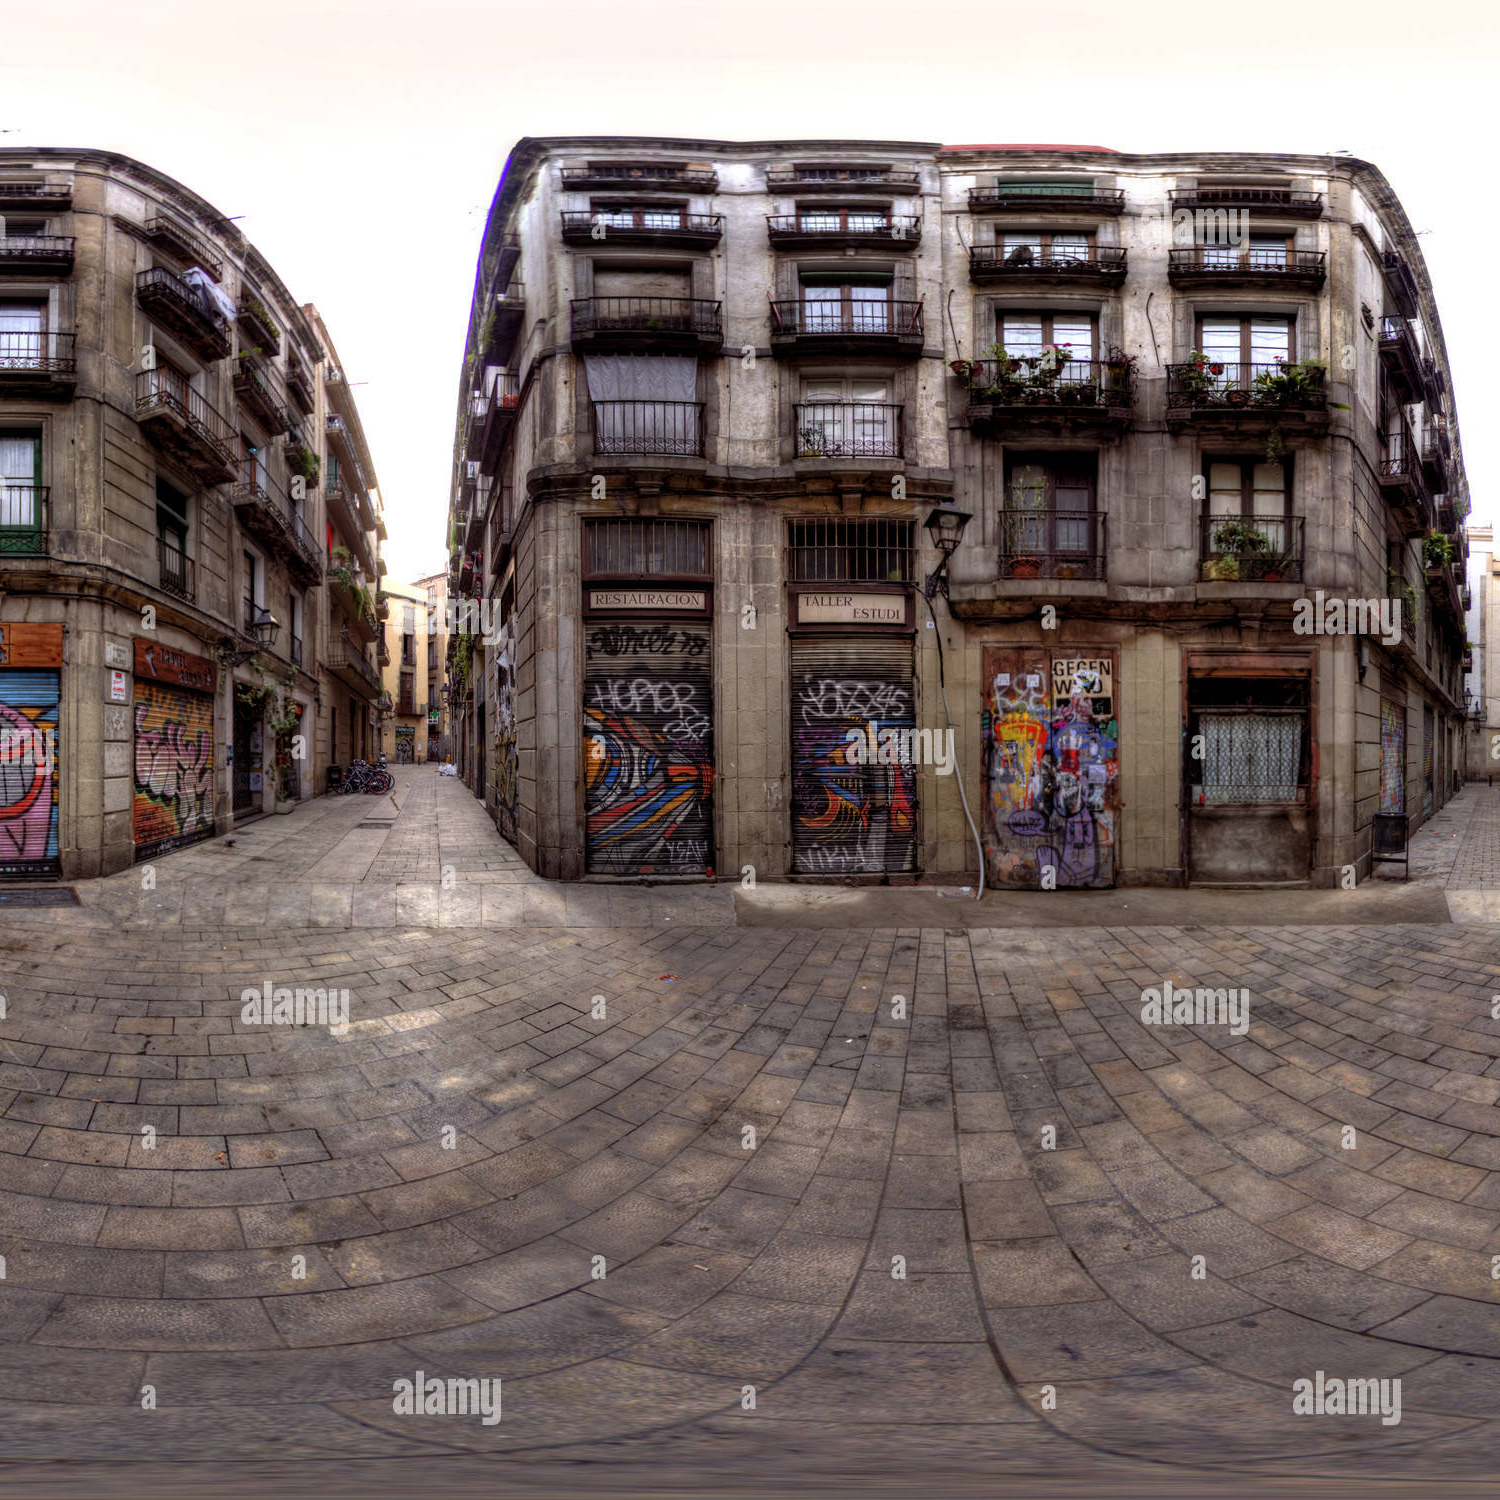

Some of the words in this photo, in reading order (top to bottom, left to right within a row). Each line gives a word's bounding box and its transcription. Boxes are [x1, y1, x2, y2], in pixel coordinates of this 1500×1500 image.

[595, 593, 701, 606] RESTAURACION
[804, 596, 853, 607] TALLER
[853, 608, 900, 620] ESTUDI
[157, 647, 188, 669] TRAVEL
